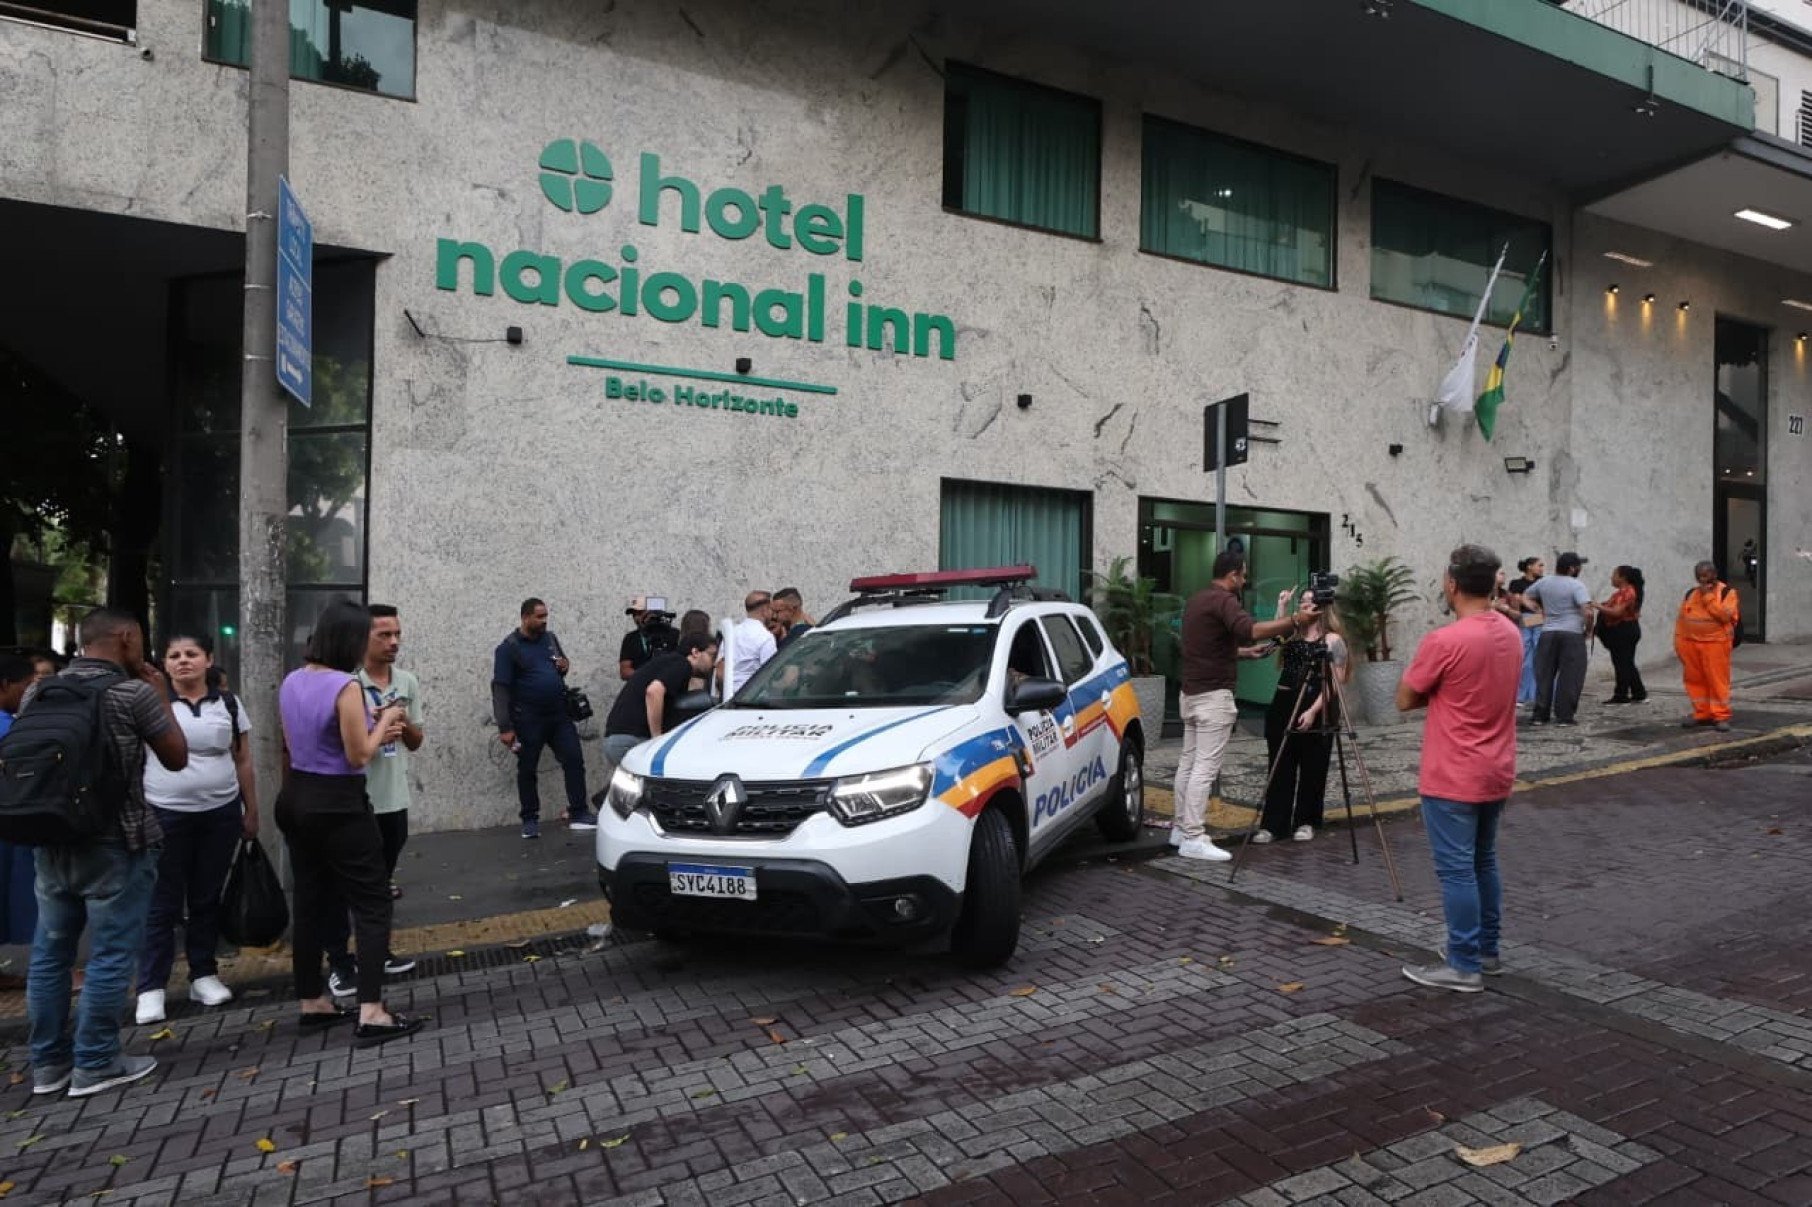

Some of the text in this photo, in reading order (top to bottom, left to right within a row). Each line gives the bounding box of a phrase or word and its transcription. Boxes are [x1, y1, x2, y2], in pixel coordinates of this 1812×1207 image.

[638, 151, 866, 262] hotel
[434, 236, 956, 361] nacional inn
[604, 375, 799, 418] Belo Horizonte
[1341, 513, 1363, 549] 215
